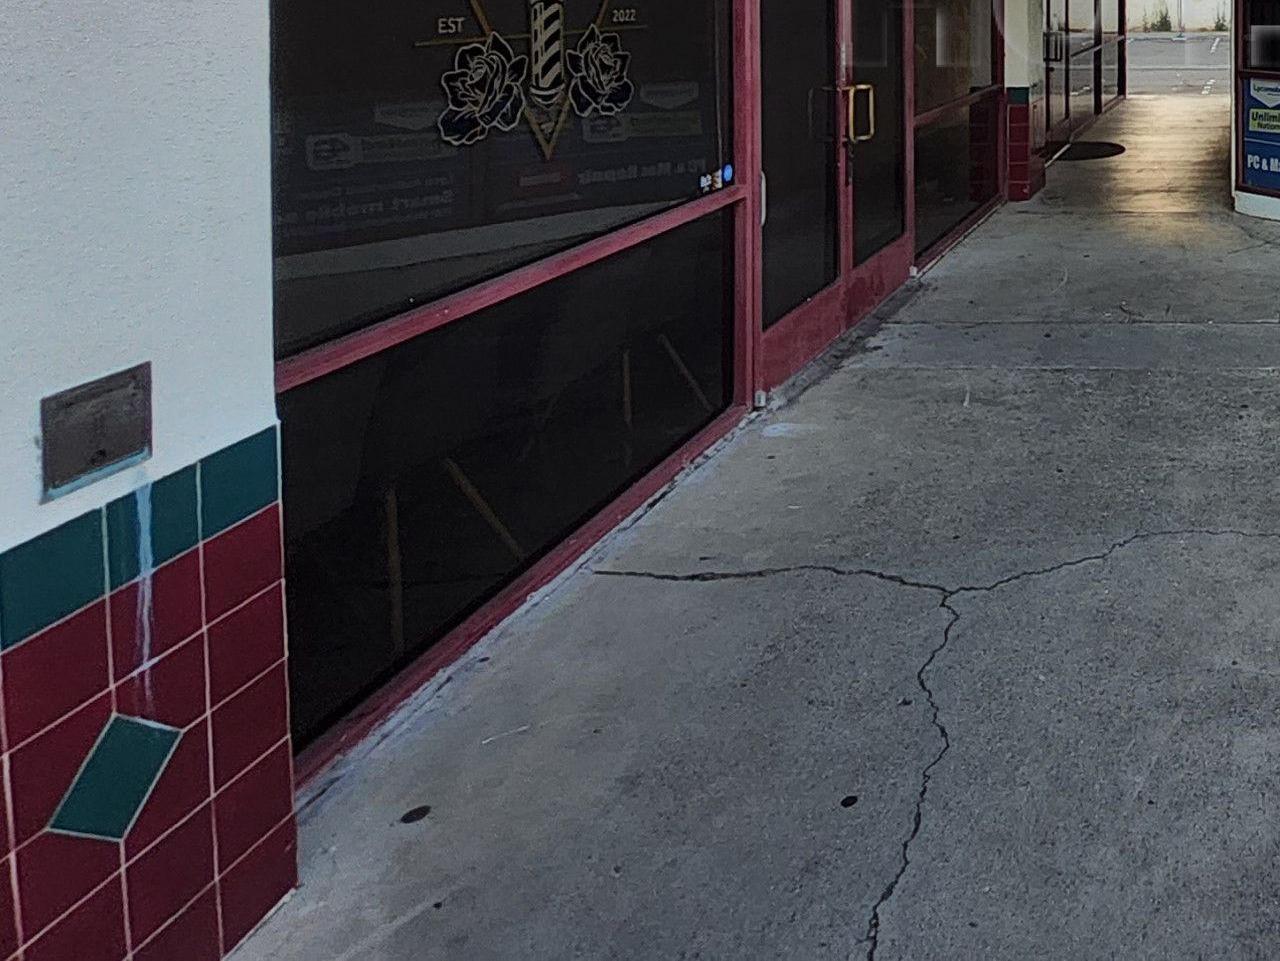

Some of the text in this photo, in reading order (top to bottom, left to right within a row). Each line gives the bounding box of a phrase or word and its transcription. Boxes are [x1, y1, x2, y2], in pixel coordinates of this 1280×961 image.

[612, 9, 637, 23] 2022
[437, 16, 465, 33] EST
[1247, 154, 1260, 169] PC
[1262, 157, 1268, 170] &
